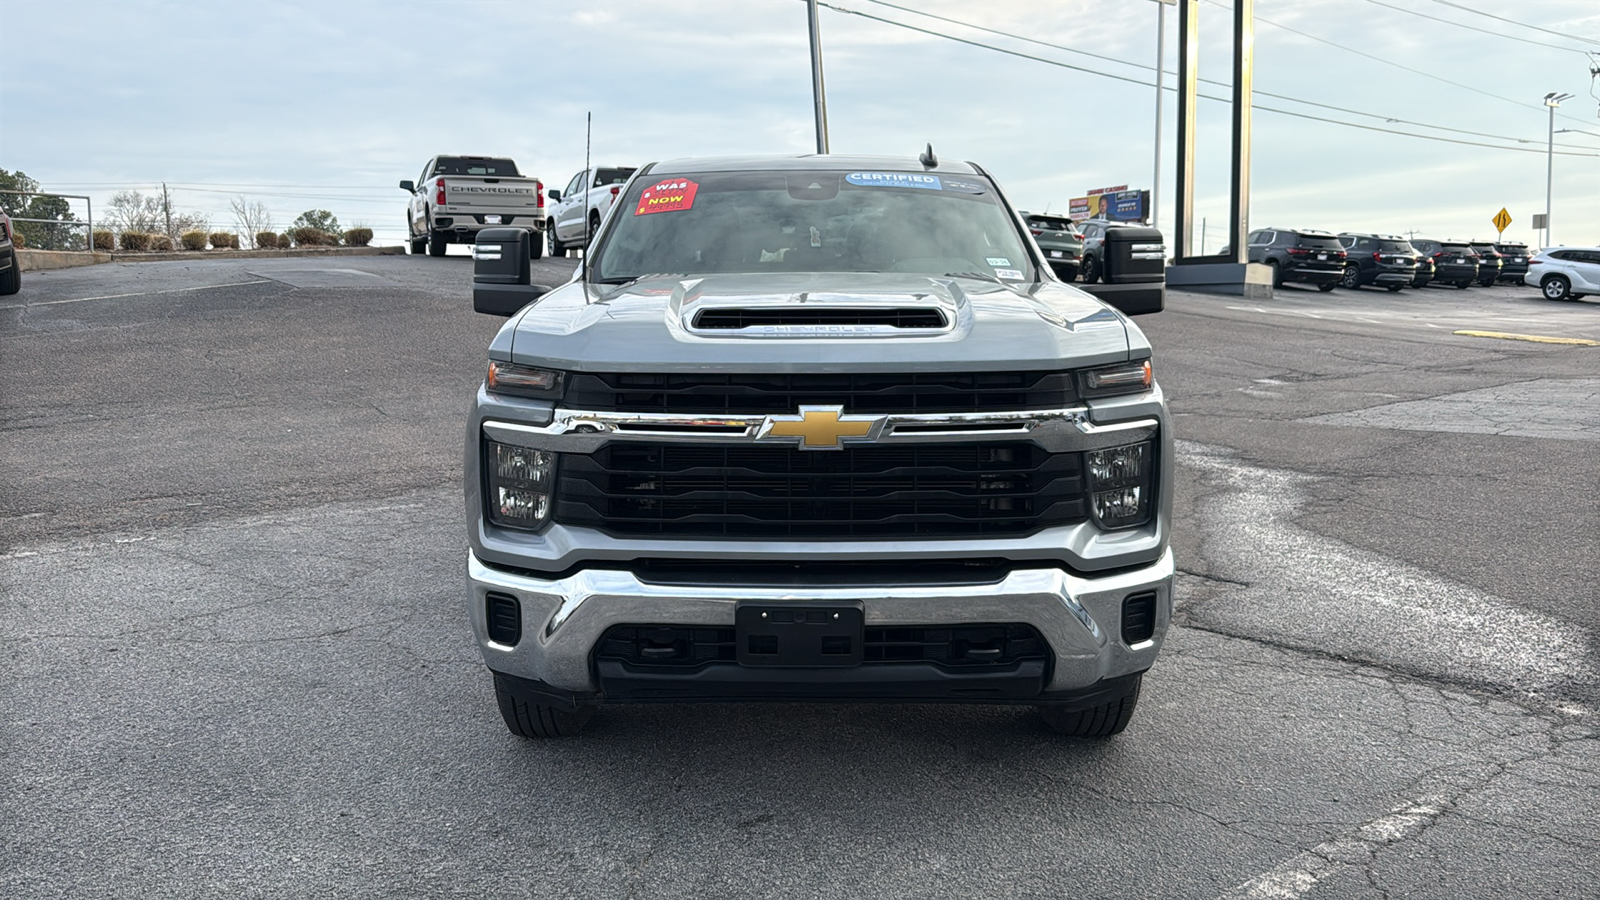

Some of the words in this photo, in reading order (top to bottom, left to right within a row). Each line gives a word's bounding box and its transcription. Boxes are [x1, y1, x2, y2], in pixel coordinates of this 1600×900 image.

[850, 173, 935, 183] CERTIFIED
[451, 186, 532, 194] CHEVROLET
[656, 182, 687, 191] WAS
[648, 195, 684, 205] NOW
[763, 326, 877, 334] CHEVROLET
